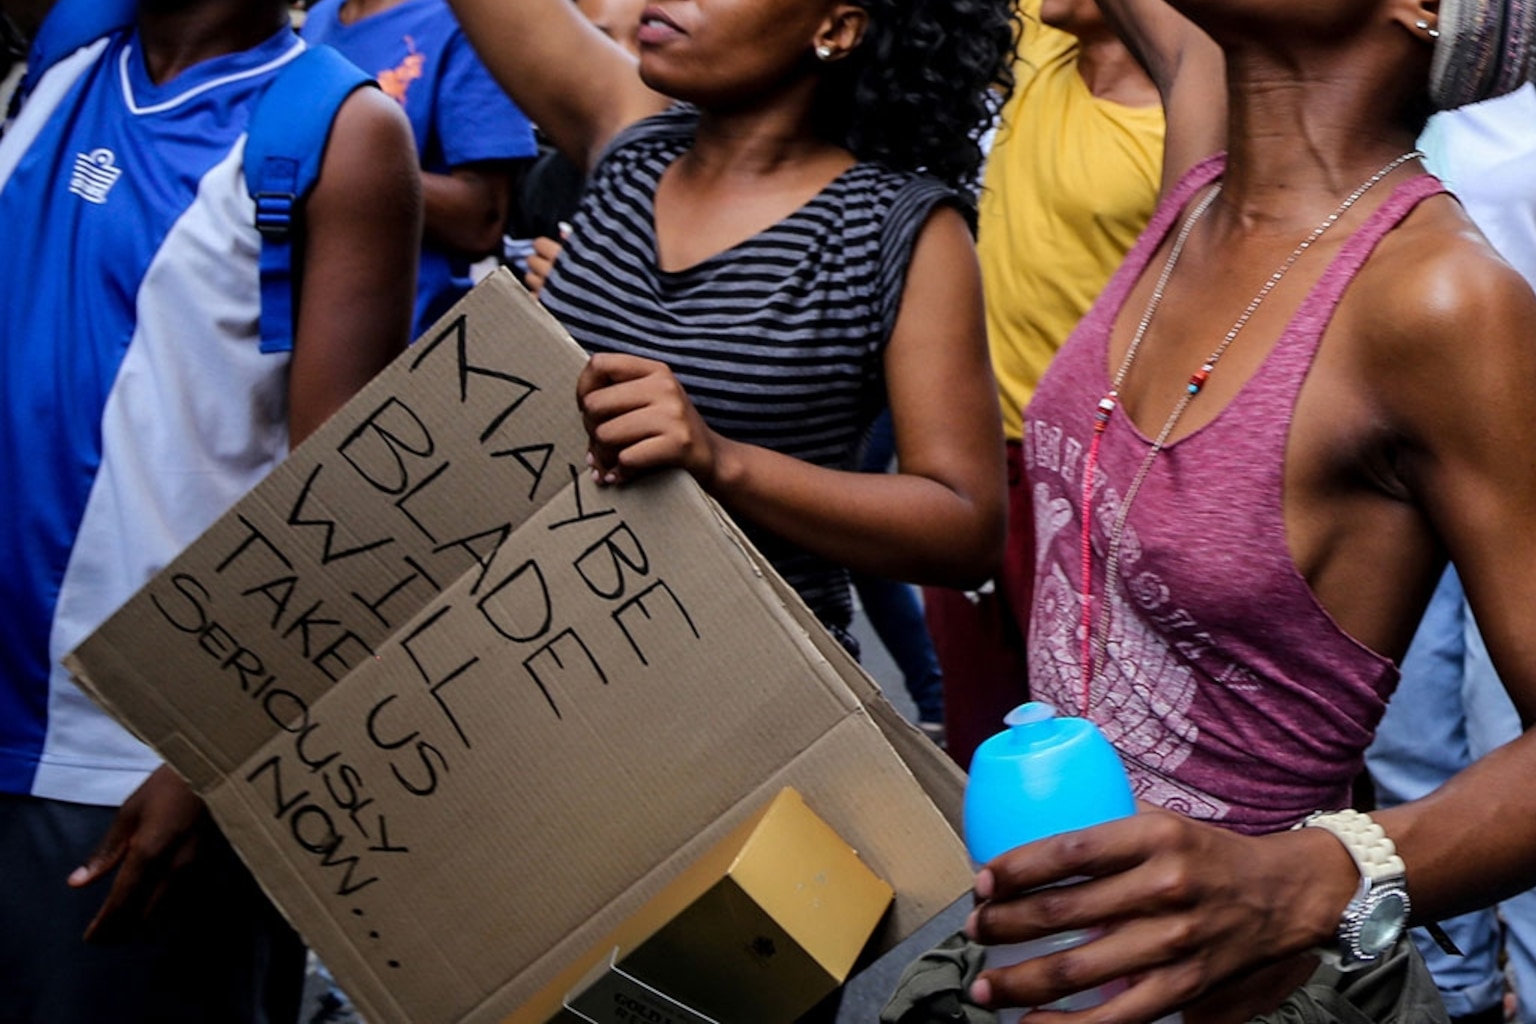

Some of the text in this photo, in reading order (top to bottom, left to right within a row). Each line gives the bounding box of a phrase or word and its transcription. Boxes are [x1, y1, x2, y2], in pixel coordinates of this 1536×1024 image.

[288, 463, 480, 748] WILL
[337, 396, 608, 720] BLADE
[410, 314, 700, 666] MAYBE
[149, 573, 409, 854] SERIOUSLY
[214, 514, 450, 796] TAKE US
